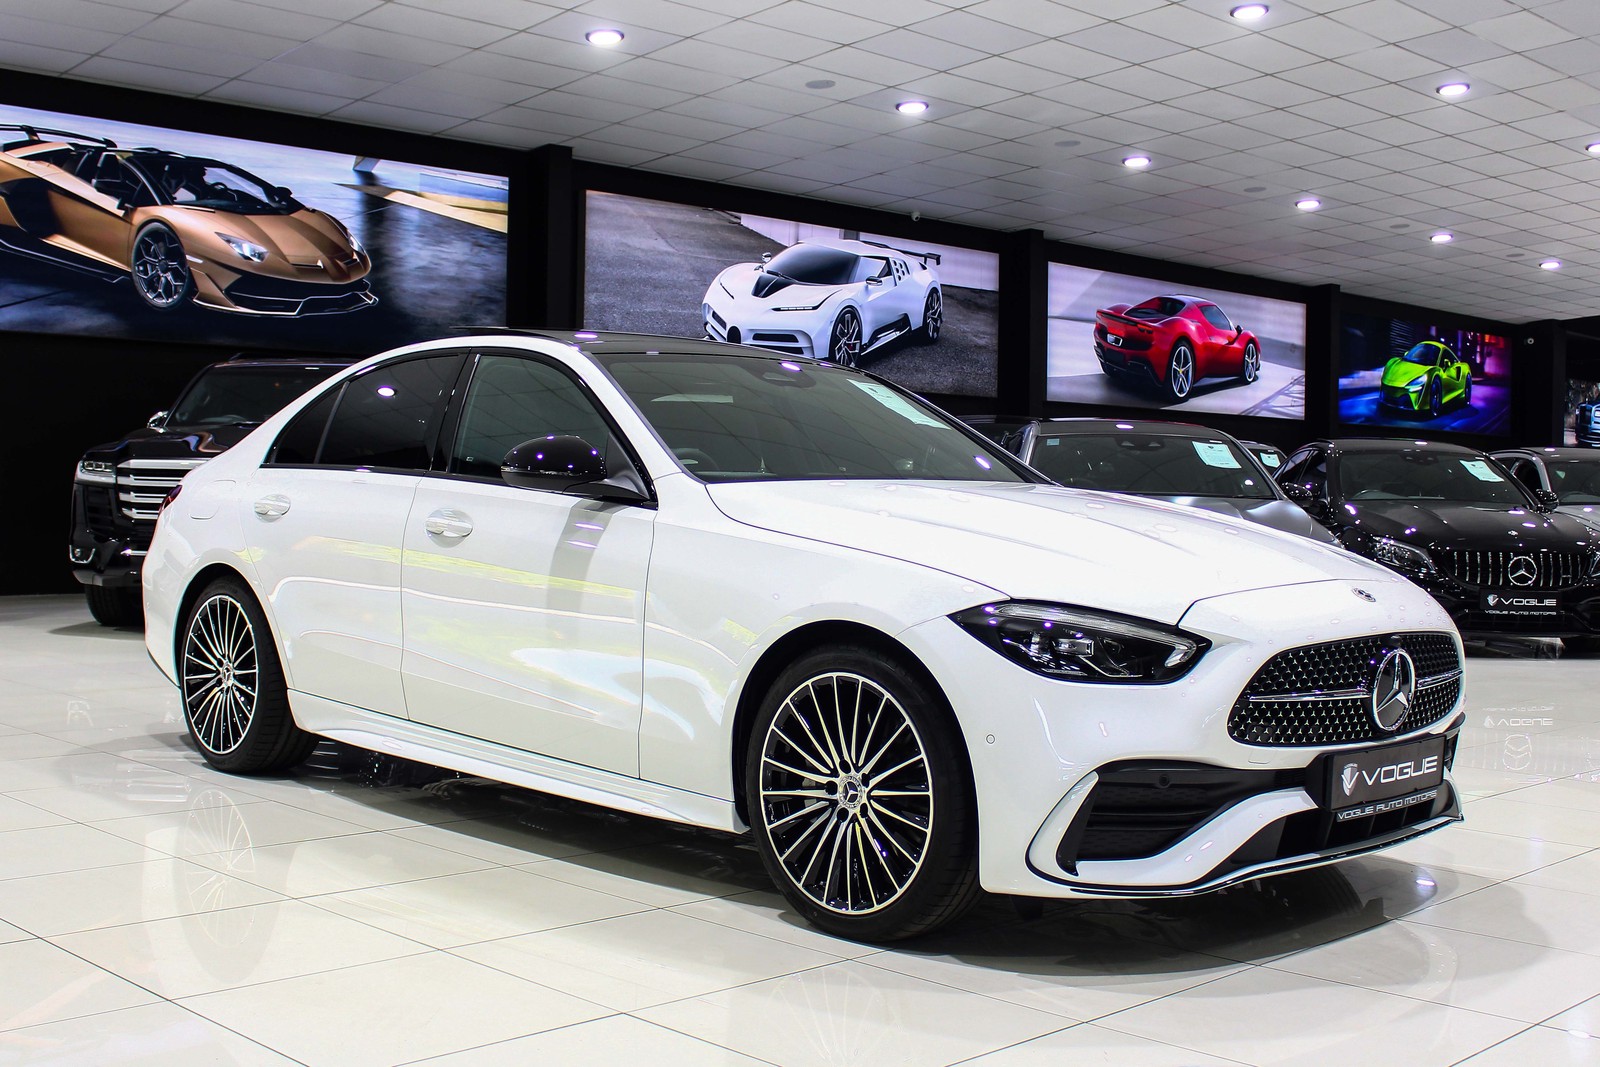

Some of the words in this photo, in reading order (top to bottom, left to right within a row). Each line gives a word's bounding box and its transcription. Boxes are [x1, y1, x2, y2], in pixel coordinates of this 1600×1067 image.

[1500, 597, 1557, 606] VOGUE
[1362, 755, 1438, 786] VOGUE
[1338, 806, 1374, 820] VOGUE
[1376, 800, 1403, 812] AUTO
[1404, 789, 1438, 805] MOTORS
